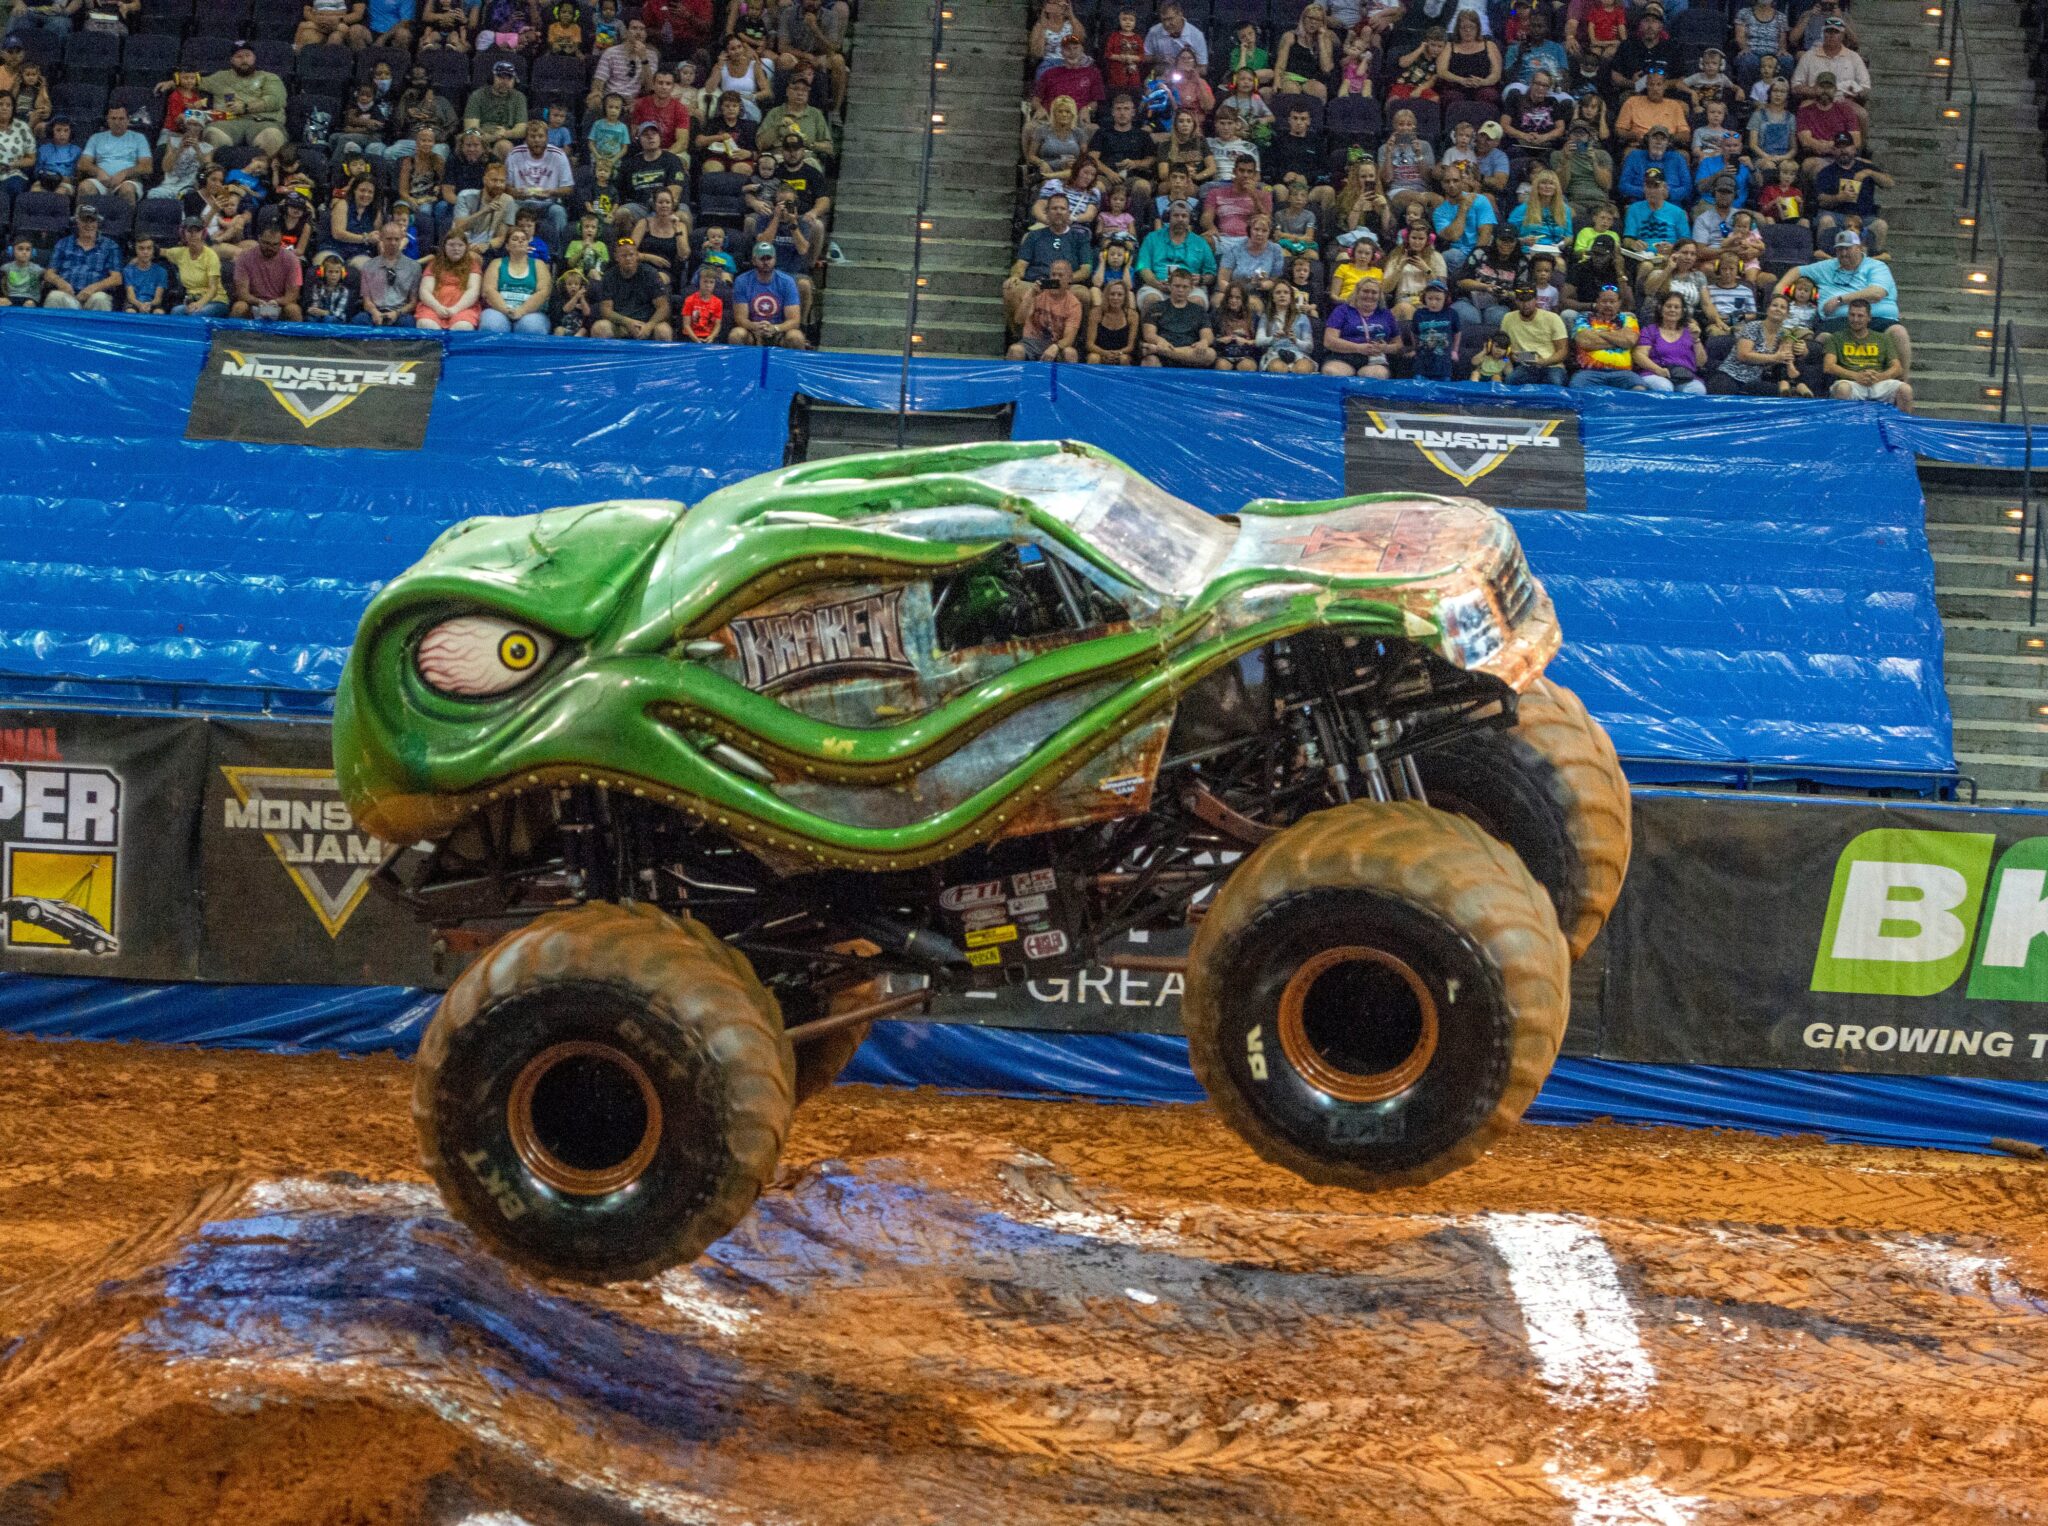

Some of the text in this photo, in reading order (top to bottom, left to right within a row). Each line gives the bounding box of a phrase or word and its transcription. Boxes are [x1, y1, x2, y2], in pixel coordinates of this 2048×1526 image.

[1843, 343, 1879, 357] DAD
[221, 361, 416, 386] MONSTER
[729, 590, 911, 690] KRAKEN
[0, 727, 64, 762] NAL
[224, 798, 353, 831] MONS
[286, 833, 382, 864] JAM
[1803, 1022, 2014, 1058] GROWING
